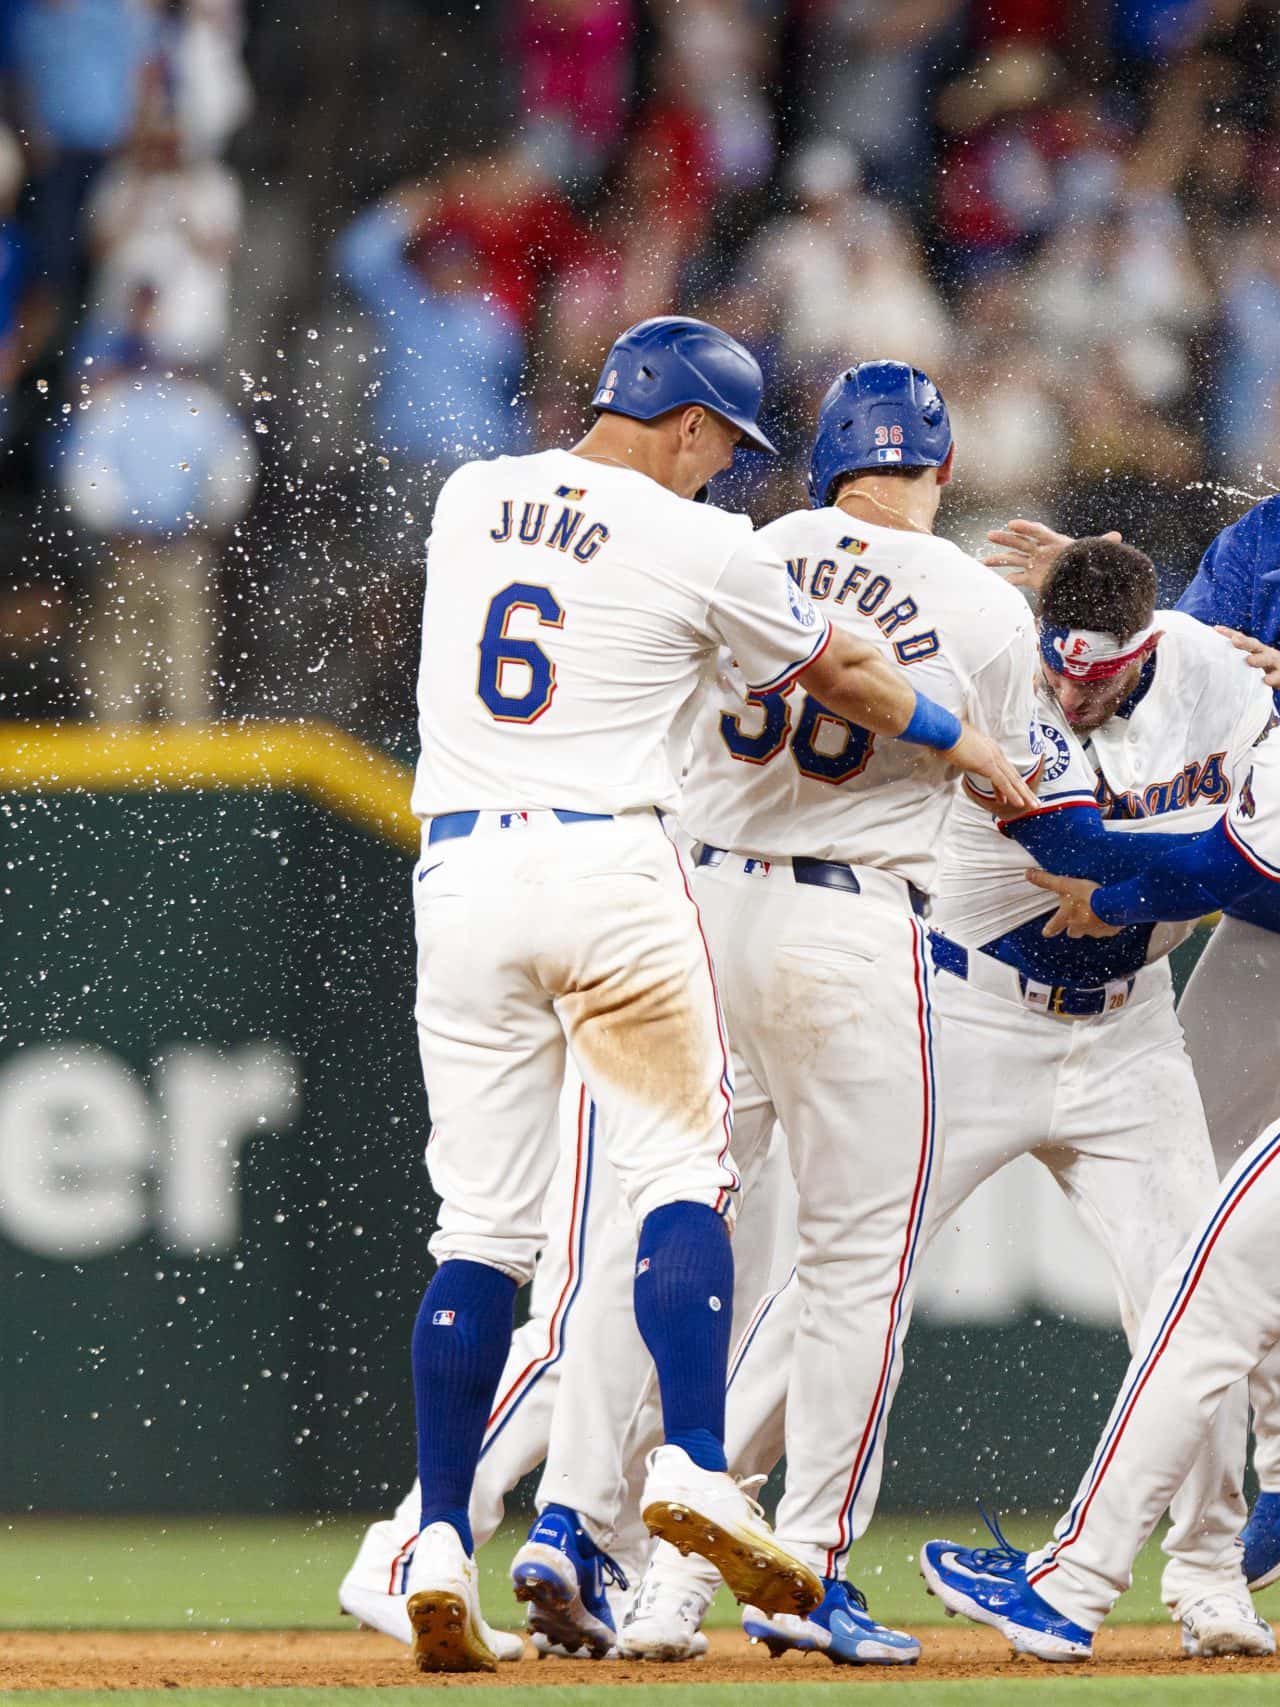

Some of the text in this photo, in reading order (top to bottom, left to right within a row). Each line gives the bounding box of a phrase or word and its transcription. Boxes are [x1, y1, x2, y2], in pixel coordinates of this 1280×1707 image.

[874, 425, 904, 445] 36
[490, 500, 610, 564] JUNG
[475, 580, 566, 724] 6
[784, 557, 941, 666] NGFORD
